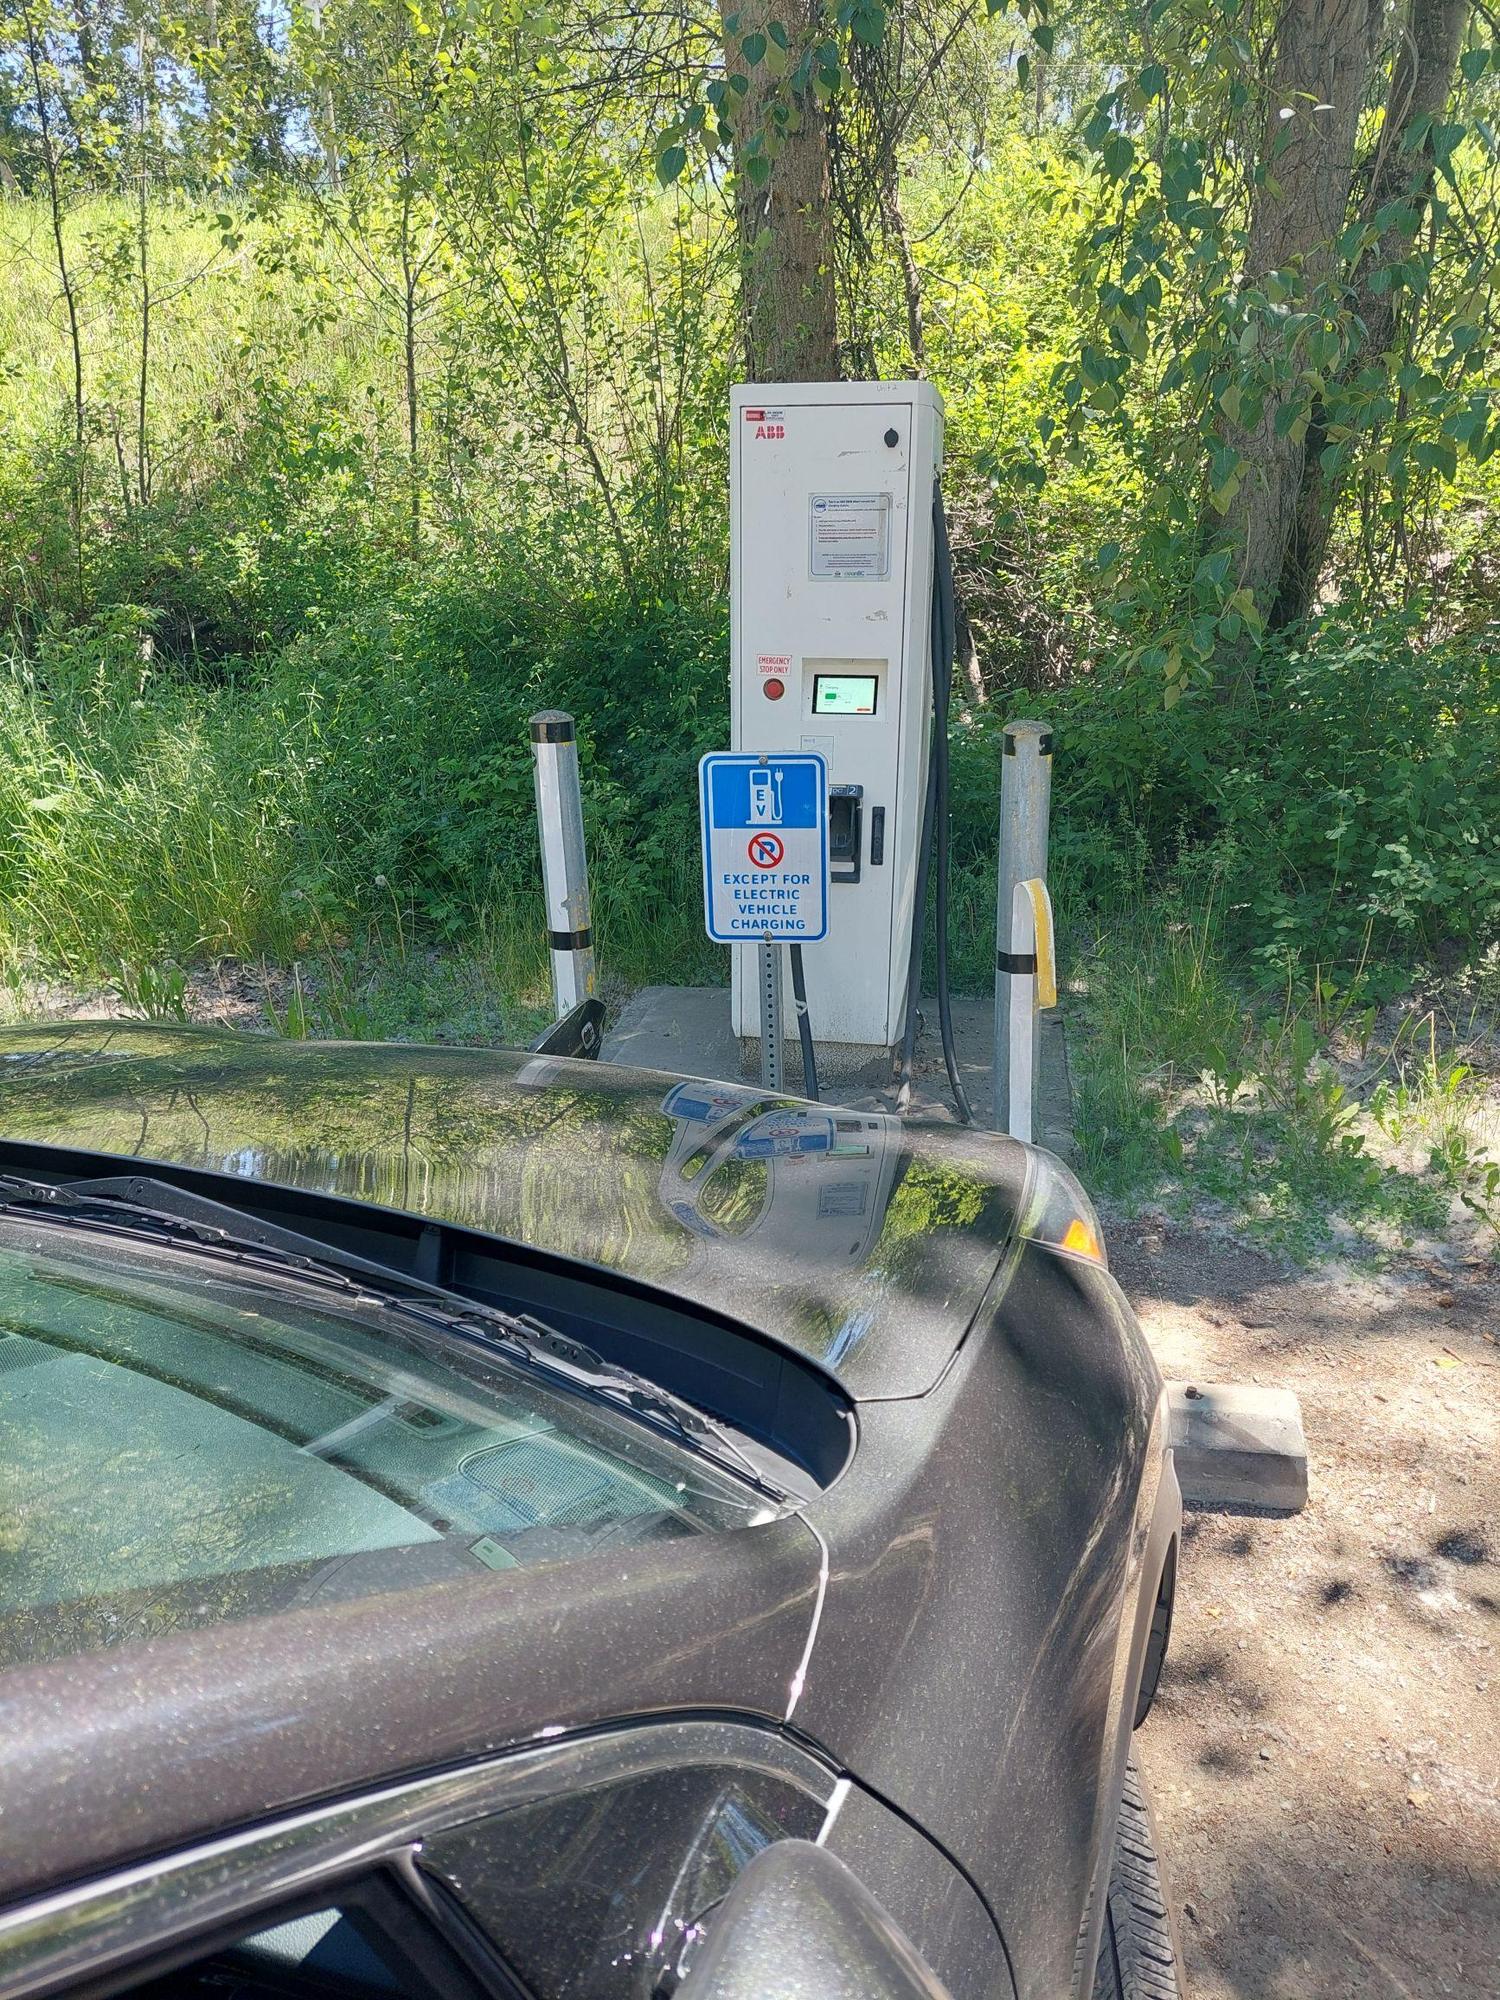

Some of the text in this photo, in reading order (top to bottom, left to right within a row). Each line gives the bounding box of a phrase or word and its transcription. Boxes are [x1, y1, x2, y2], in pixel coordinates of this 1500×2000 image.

[755, 426, 785, 439] ABB
[759, 656, 790, 665] EMERGENCY
[849, 786, 856, 795] 2
[723, 874, 810, 885] EXCEPT FOR
[734, 889, 800, 900] ELECTRIC
[739, 904, 797, 915] VEHICLE
[731, 919, 806, 930] CHARGING
